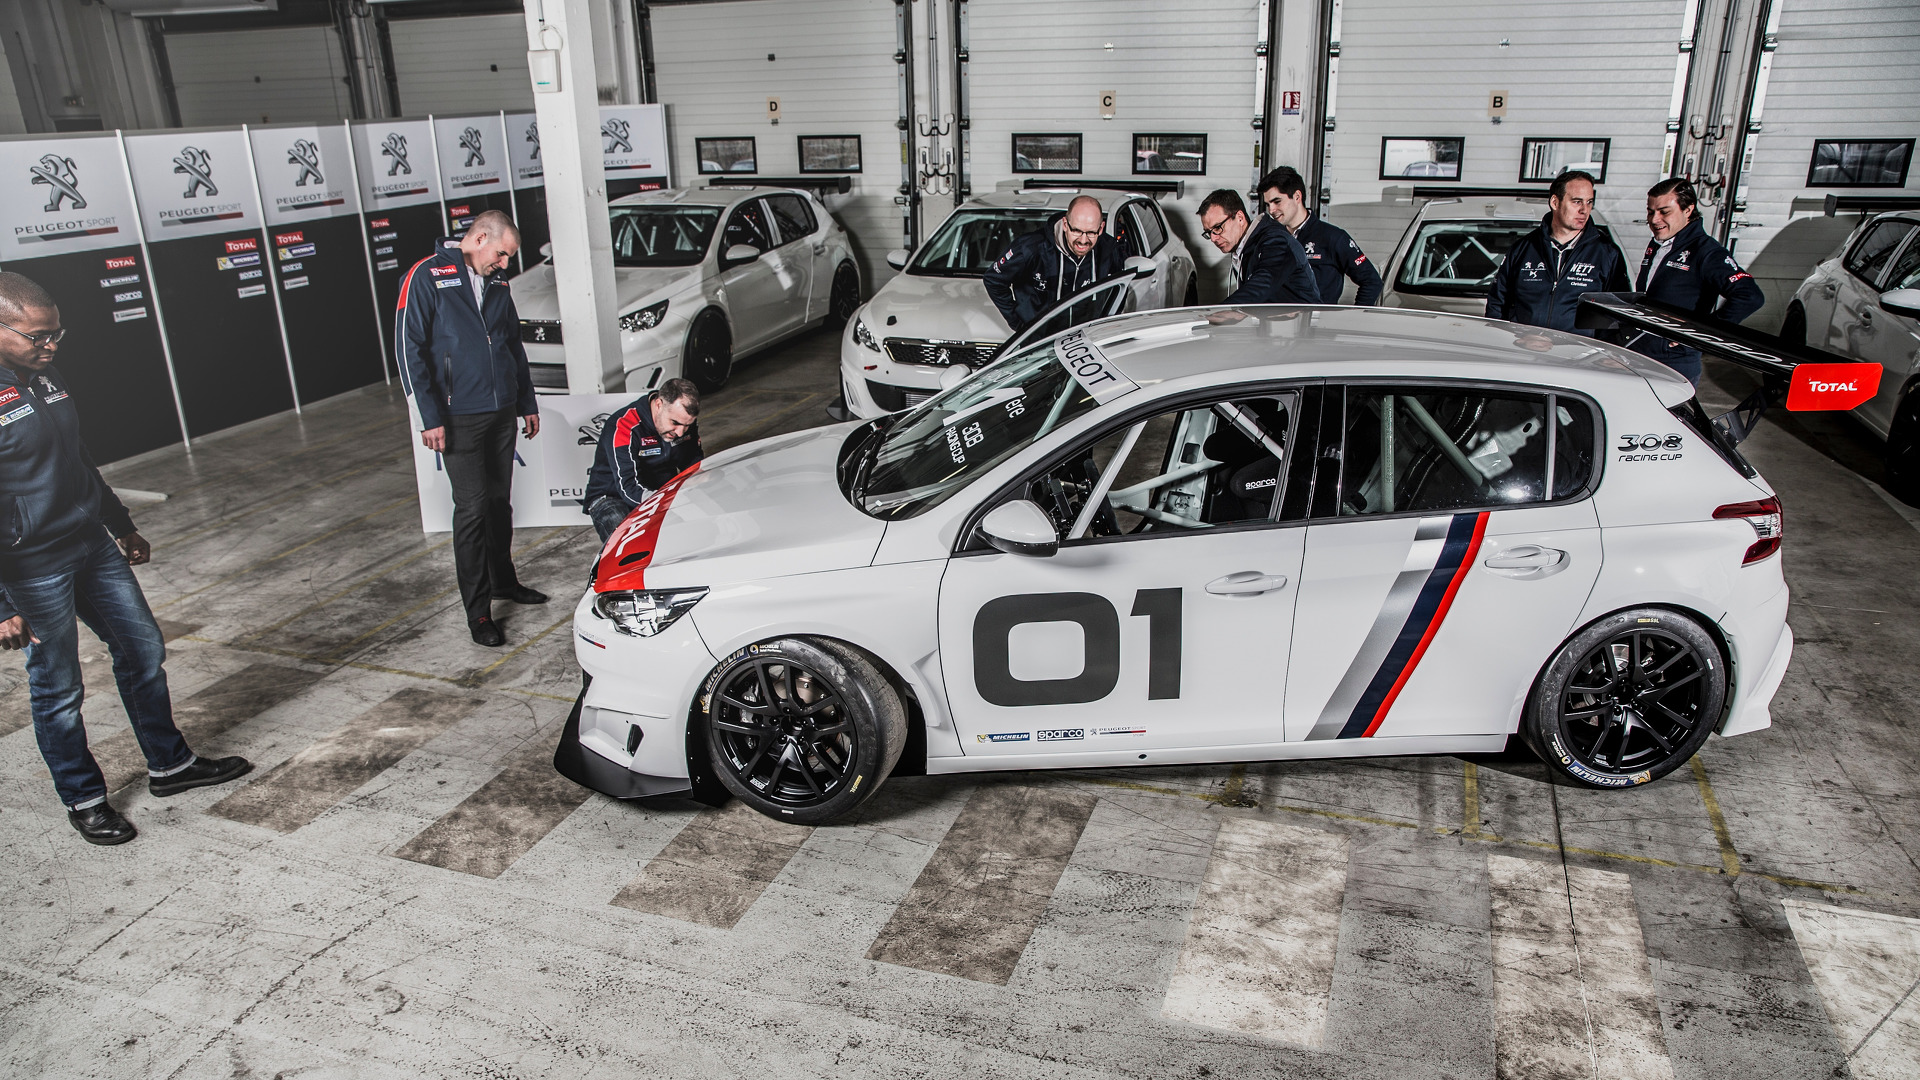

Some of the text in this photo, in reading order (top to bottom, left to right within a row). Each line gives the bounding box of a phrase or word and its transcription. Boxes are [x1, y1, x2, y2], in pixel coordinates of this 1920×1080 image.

[769, 101, 778, 112] D
[1103, 95, 1112, 107] C
[1493, 96, 1503, 108] B
[518, 165, 543, 174] PEUGEO
[450, 170, 499, 183] PEUGEOT SPORT
[372, 179, 428, 193] PEUGEOT SPORT
[276, 190, 344, 205] PEUGEOT SPORT
[159, 203, 242, 218] PEUGEOT SPORT
[451, 208, 470, 216] TOTAL
[15, 216, 117, 235] PEUGEOT SPORT
[372, 220, 390, 228] TOTAL
[278, 234, 304, 244] TOTAL
[227, 241, 257, 251] TOTAL
[106, 258, 136, 269] TOTAL
[1570, 263, 1595, 274] NETT
[437, 266, 457, 275] TOTAL
[1611, 306, 1798, 368] PEUGEO
[1809, 380, 1858, 393] TOTAL
[0, 391, 19, 403] OTAL
[961, 421, 984, 448] 308
[1617, 433, 1683, 451] 308
[1245, 478, 1276, 489] sparco
[549, 488, 583, 498] PEU
[615, 480, 682, 557] TOTAL
[973, 587, 1183, 707] 01
[705, 647, 746, 692] MICHELIN
[992, 733, 1029, 742] MICHELIN
[1037, 729, 1084, 741] sparco
[1570, 765, 1628, 786] MICHELIN
